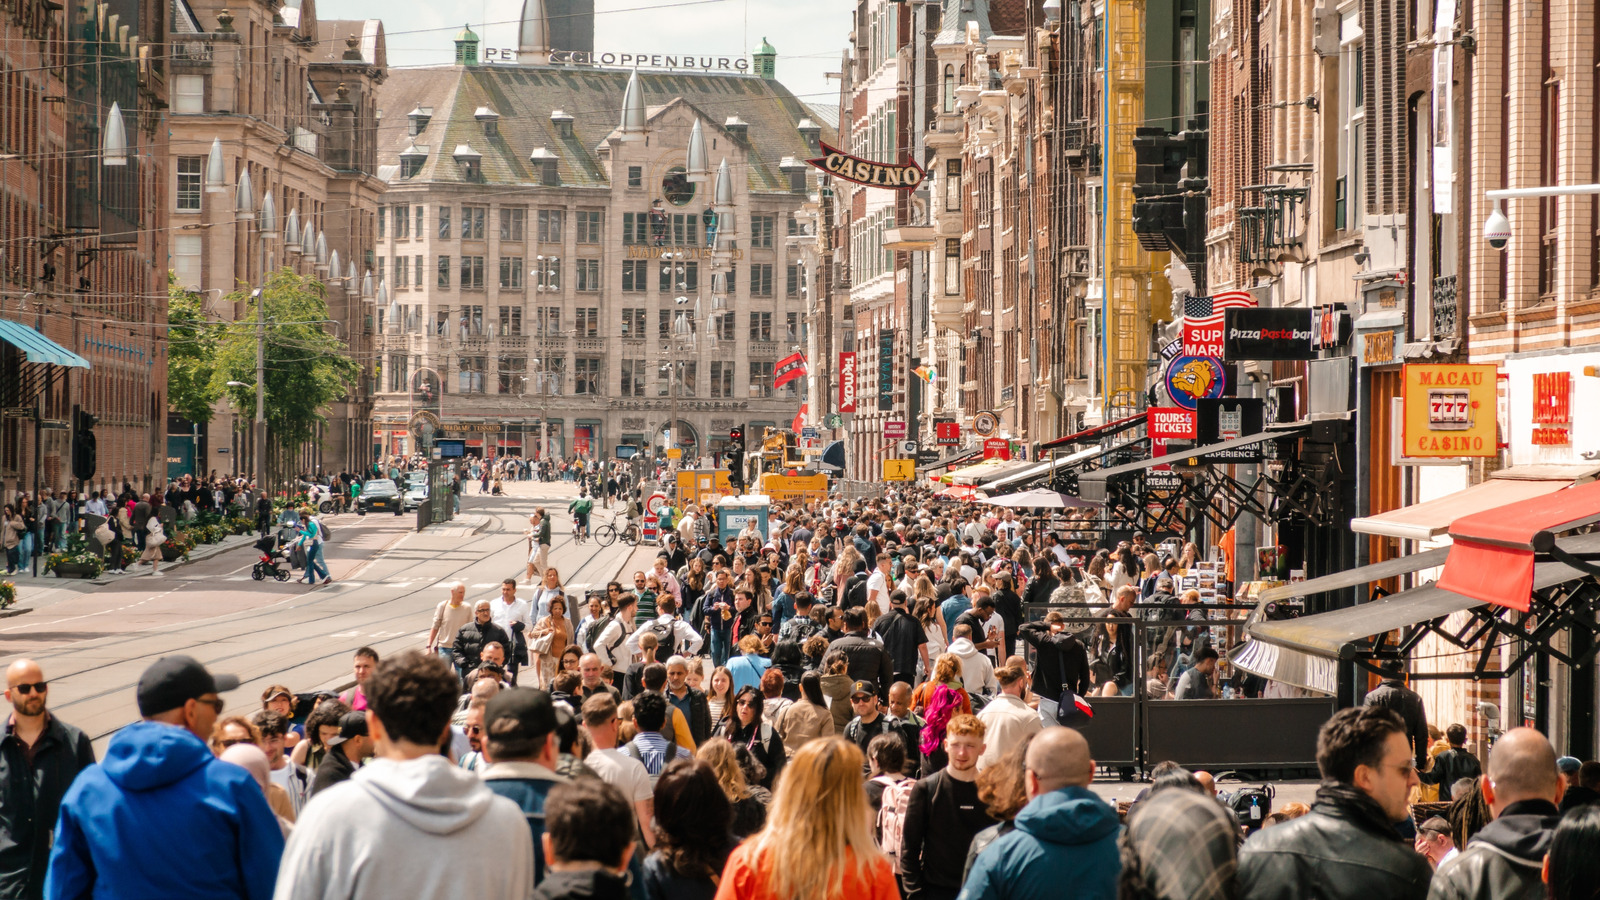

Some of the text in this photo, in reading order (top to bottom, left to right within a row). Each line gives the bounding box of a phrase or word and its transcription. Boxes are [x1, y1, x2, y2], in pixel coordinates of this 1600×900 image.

[75, 37, 87, 92] VAN
[569, 51, 749, 70] CLOPPENBURG
[825, 152, 921, 186] CASINO
[627, 246, 683, 259] MADA
[1190, 329, 1224, 342] SUP
[1162, 340, 1183, 358] THE
[881, 337, 892, 404] PRIMARK
[1419, 371, 1483, 386] MACAU
[655, 401, 749, 411] CLPPENBURG
[1431, 402, 1468, 413] 7 7 7
[1154, 423, 1192, 433] TICKETS
[1146, 478, 1168, 486] STEAK
[856, 682, 863, 691] P
